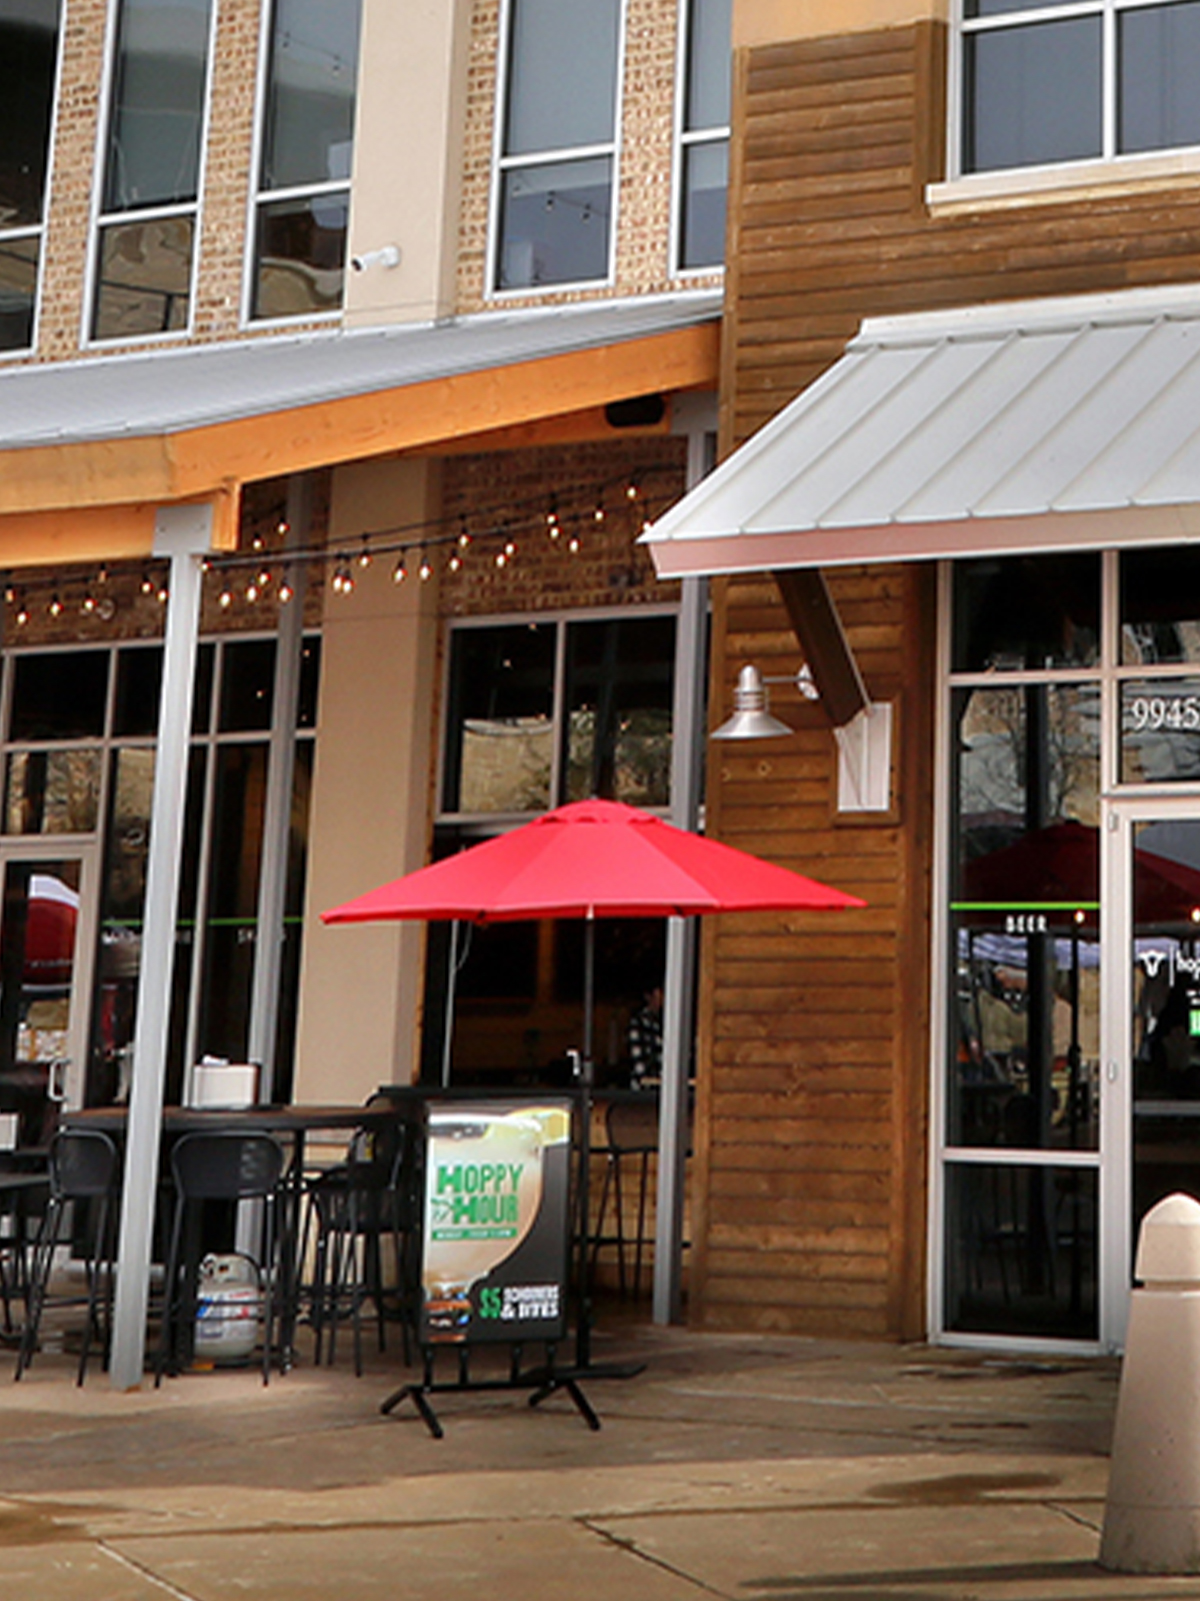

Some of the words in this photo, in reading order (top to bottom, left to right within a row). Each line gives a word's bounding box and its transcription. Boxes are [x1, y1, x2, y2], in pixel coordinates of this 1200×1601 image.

[1132, 697, 1200, 730] 9945
[1006, 914, 1047, 933] BEER
[437, 1163, 523, 1194] HOPPY
[452, 1195, 519, 1224] HOUR
[480, 1287, 500, 1318] $5
[500, 1303, 515, 1319] &
